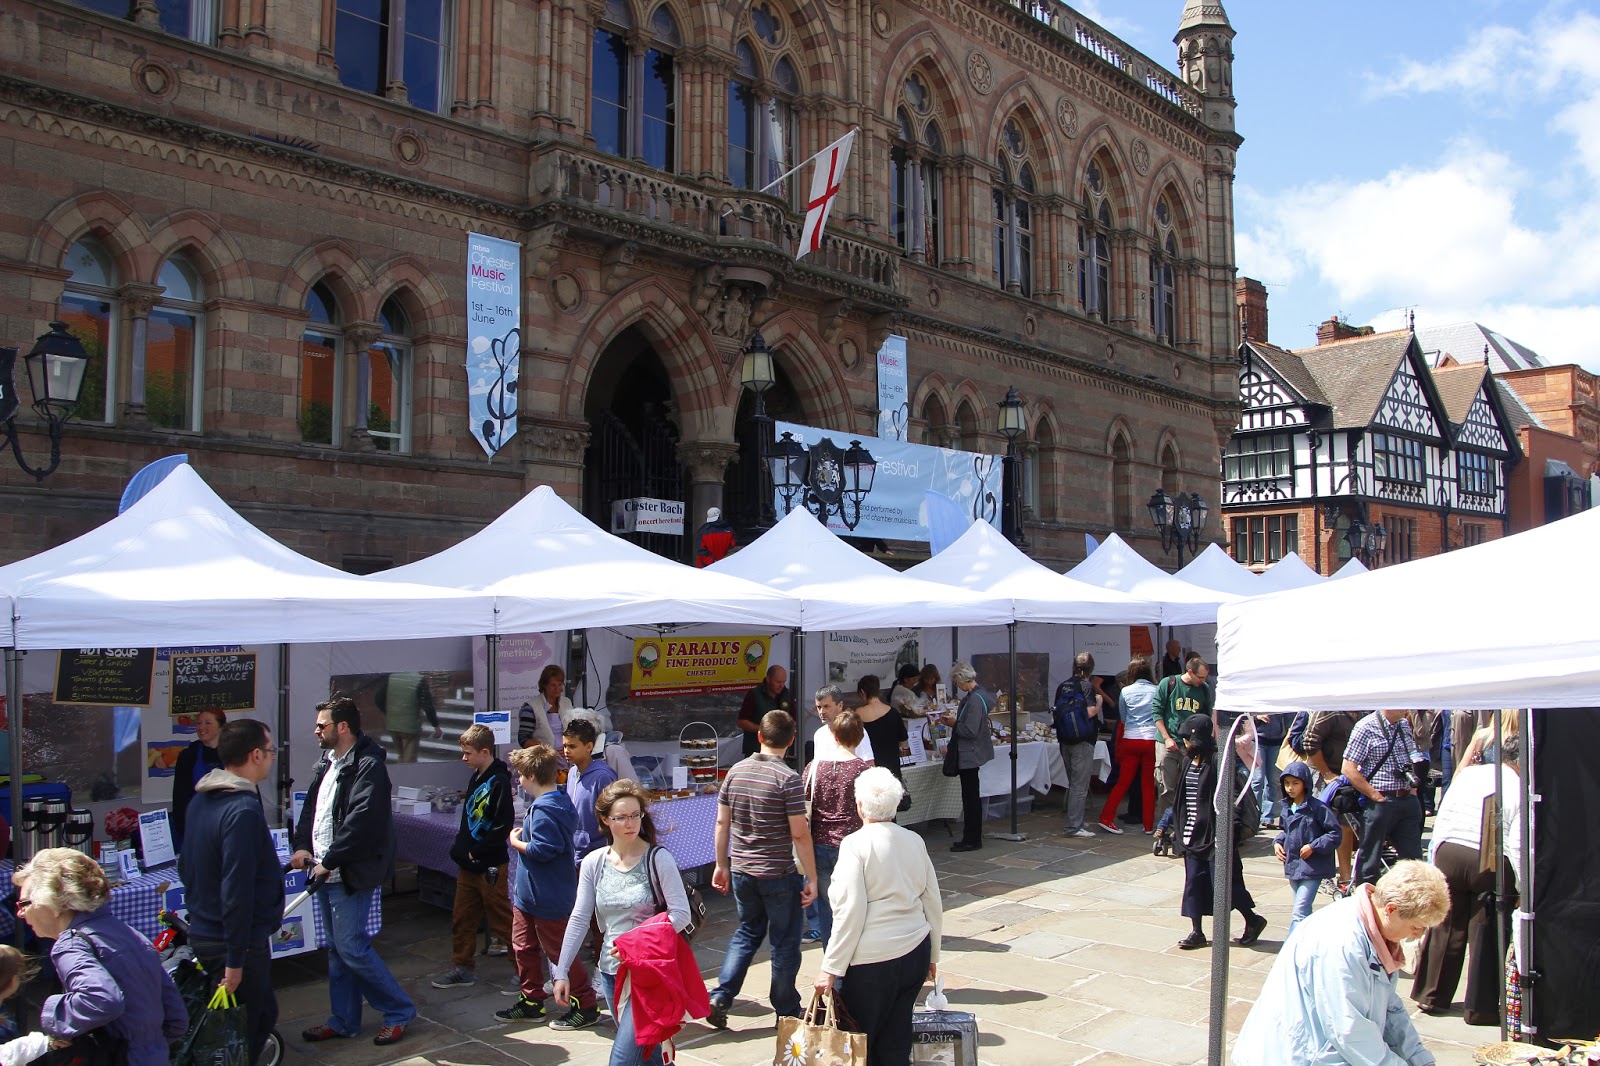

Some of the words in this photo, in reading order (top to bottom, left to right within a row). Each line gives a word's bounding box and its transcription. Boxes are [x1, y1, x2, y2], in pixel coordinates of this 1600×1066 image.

[472, 244, 490, 253] mbna
[471, 252, 515, 271] Chester
[471, 264, 506, 281] Music
[471, 277, 513, 296] Festival
[471, 301, 484, 312] 1st
[495, 305, 514, 317] 16th
[471, 312, 496, 325] June
[879, 354, 899, 367] Music
[880, 391, 894, 400] June
[875, 456, 919, 478] Festival
[624, 501, 659, 512] Chester
[660, 502, 683, 514] Bach
[870, 505, 897, 515] performed
[871, 514, 894, 523] chamber
[893, 517, 918, 525] musicians
[500, 638, 535, 648] crummy
[873, 636, 895, 644] Natural
[105, 648, 139, 657] SOUP
[499, 648, 542, 659] omethings
[666, 641, 741, 657] FARALY'S
[176, 657, 204, 666] COLD
[207, 656, 238, 664] SOUP
[666, 658, 690, 668] FINE
[692, 657, 738, 667] PRODUCE
[177, 664, 199, 675] VEG
[205, 661, 255, 673] SMOOTHIES
[686, 669, 716, 677] CHESTER
[176, 675, 210, 685] PASTA
[212, 672, 249, 683] SAUCE
[173, 694, 208, 705] GLUTEN
[1175, 697, 1200, 713] GAP
[918, 1032, 954, 1044] Desire
